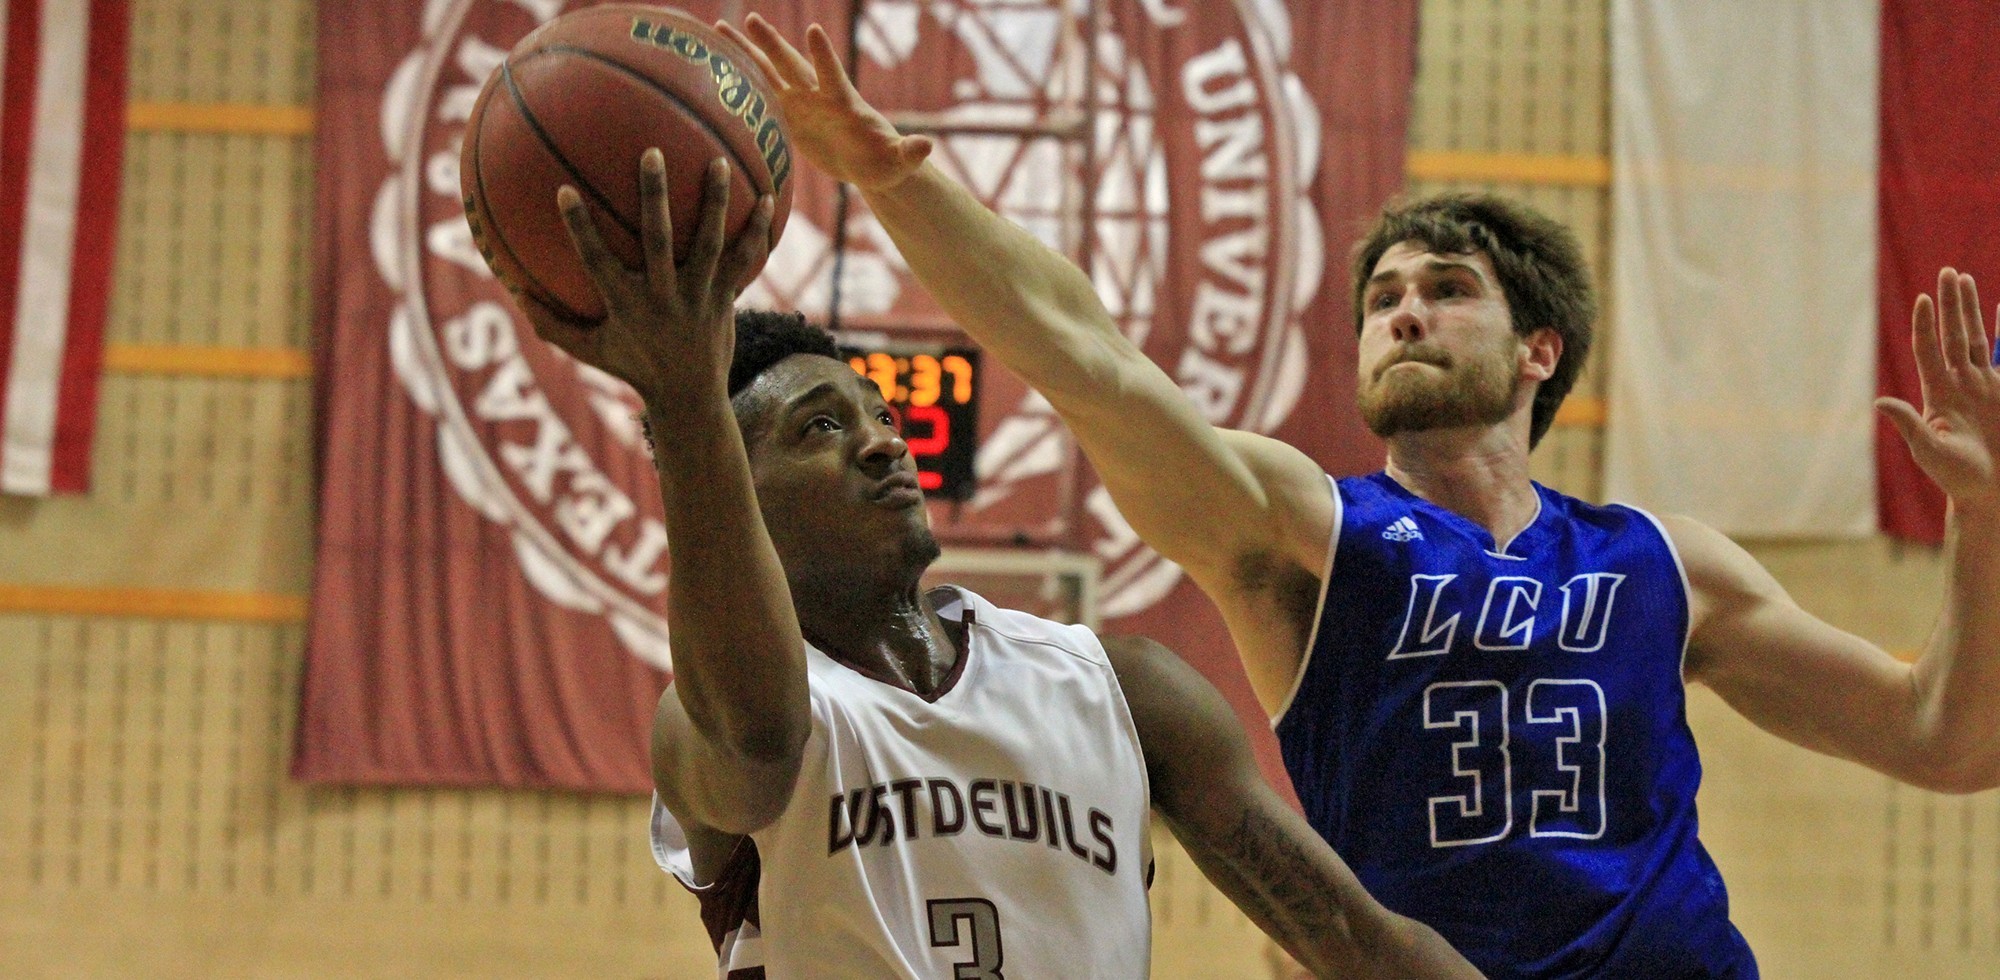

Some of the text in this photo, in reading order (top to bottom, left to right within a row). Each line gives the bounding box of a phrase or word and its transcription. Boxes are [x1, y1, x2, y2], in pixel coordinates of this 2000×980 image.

[1181, 37, 1268, 425] UNIVER
[443, 302, 671, 595] TEXAS
[1387, 573, 1626, 660] LCU
[1423, 679, 1607, 848] 33
[926, 897, 1004, 980] 3
